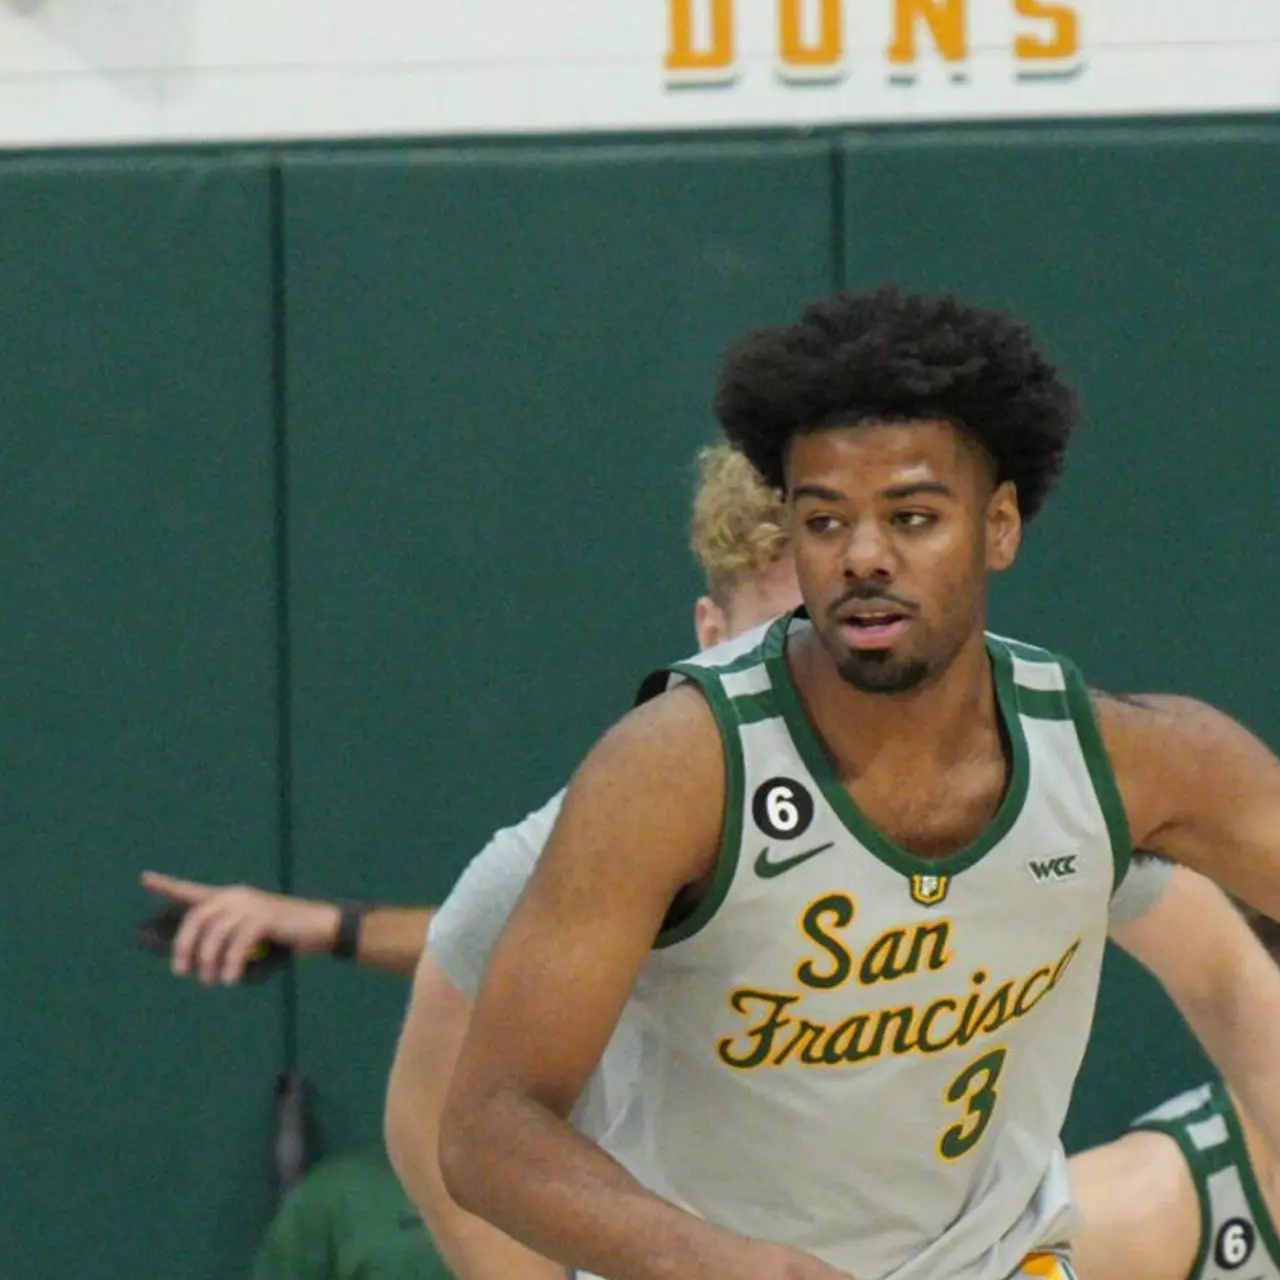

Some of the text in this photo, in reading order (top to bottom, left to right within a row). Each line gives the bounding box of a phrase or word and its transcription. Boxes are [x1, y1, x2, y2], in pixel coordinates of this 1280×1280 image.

[795, 891, 953, 990] San
[718, 932, 1083, 1071] Francisco
[935, 1046, 1009, 1163] 3
